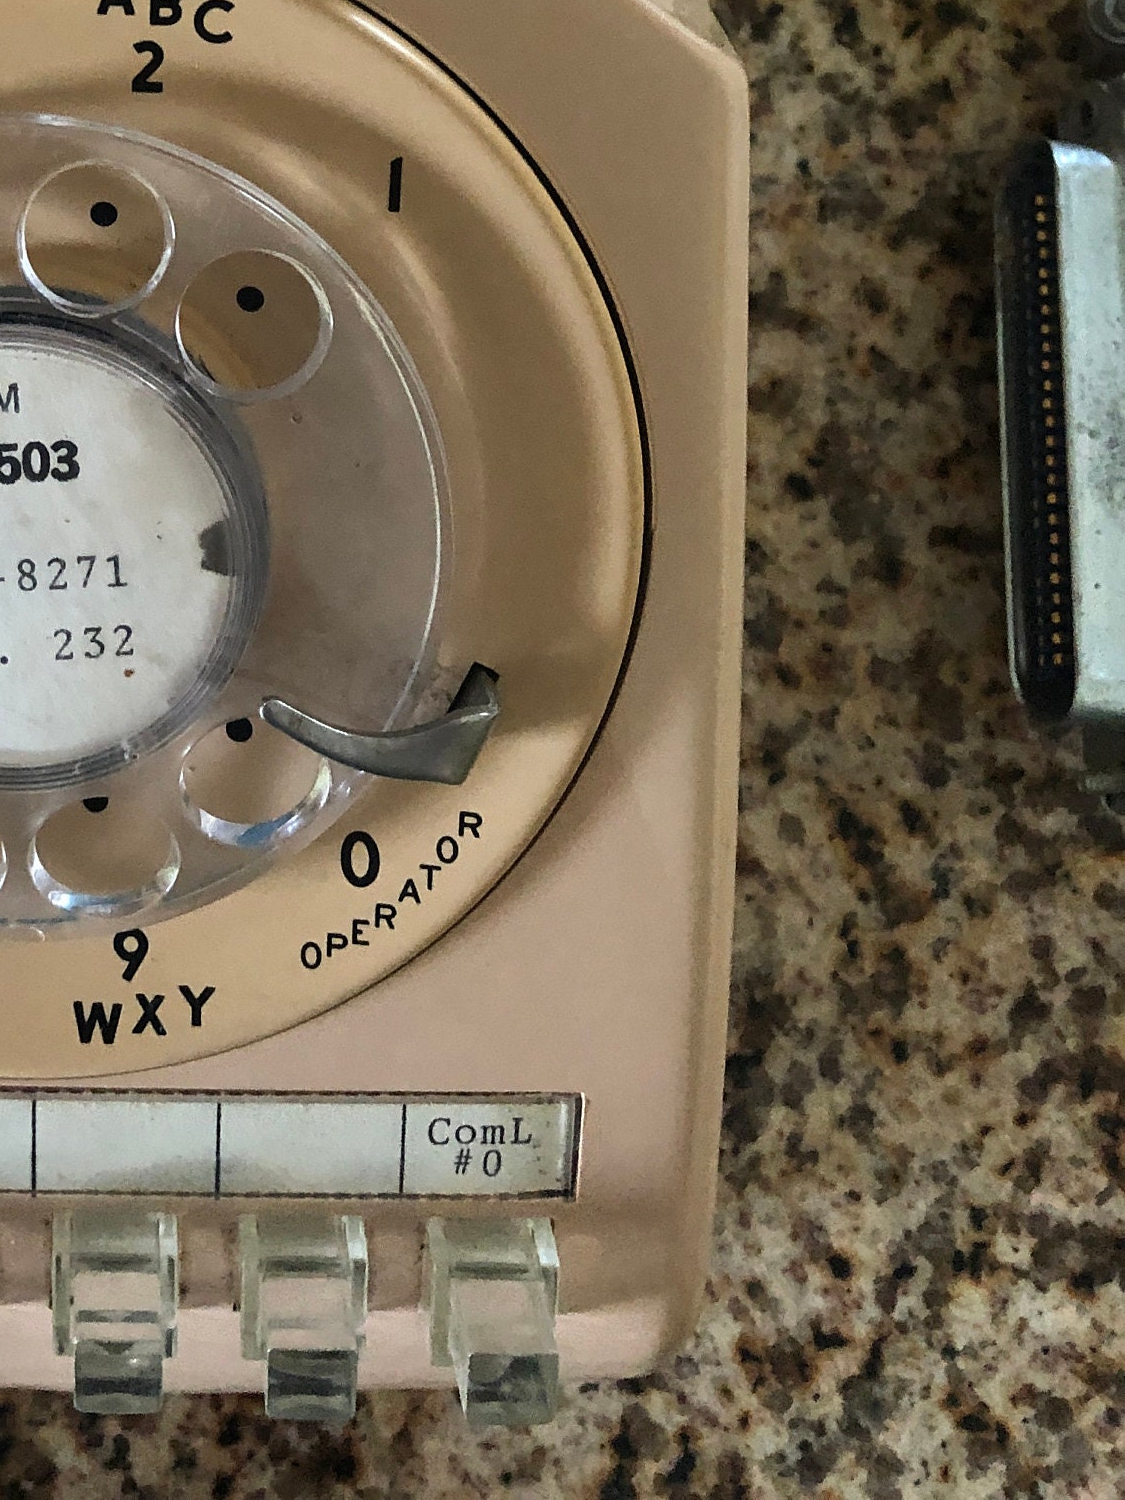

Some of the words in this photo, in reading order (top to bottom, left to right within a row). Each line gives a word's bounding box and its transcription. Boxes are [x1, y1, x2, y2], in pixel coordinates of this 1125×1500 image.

[131, 40, 165, 94] 2
[52, 624, 135, 661] 232
[299, 810, 484, 971] OPERATOR
[112, 927, 150, 982] 9
[72, 984, 217, 1046] WXY
[427, 1116, 534, 1147] ComL
